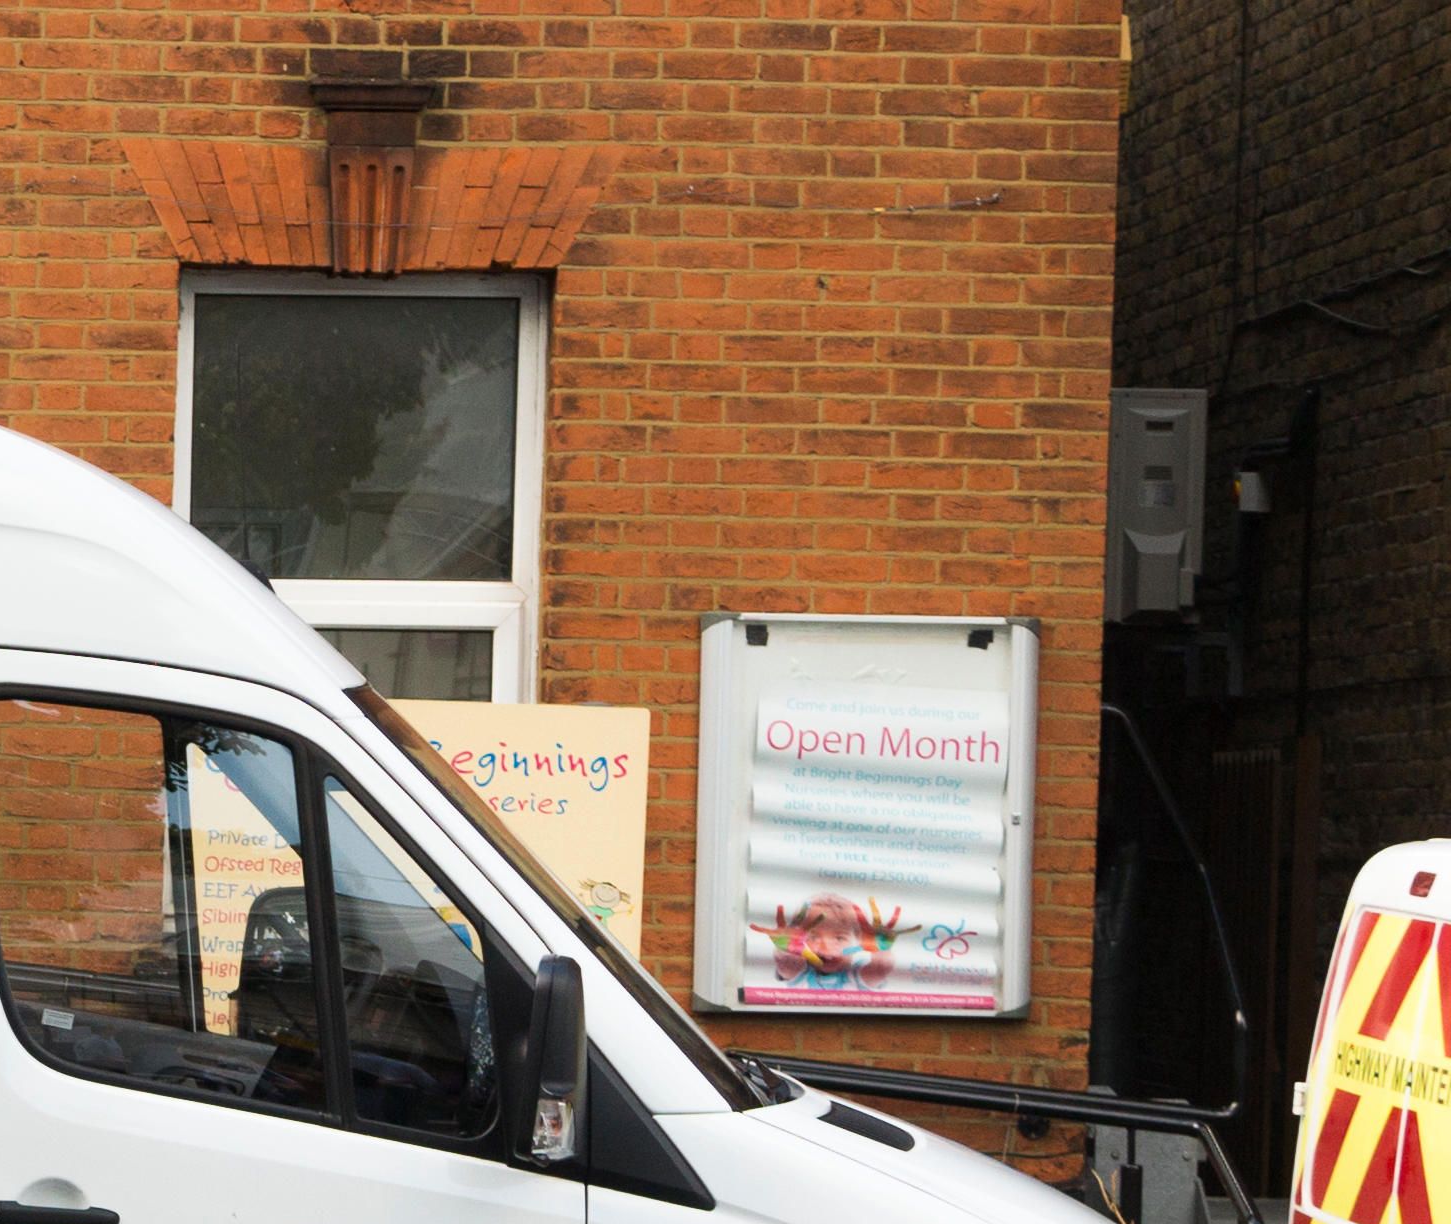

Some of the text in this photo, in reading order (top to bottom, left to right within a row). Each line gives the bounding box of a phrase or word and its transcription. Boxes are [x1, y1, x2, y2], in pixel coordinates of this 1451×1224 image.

[766, 719, 1000, 764] Open Month
[429, 740, 629, 792] eginnings
[208, 829, 268, 846] Private
[204, 856, 265, 873] Ofsted
[201, 961, 238, 978] High
[1333, 1041, 1392, 1088] HIGHWAY
